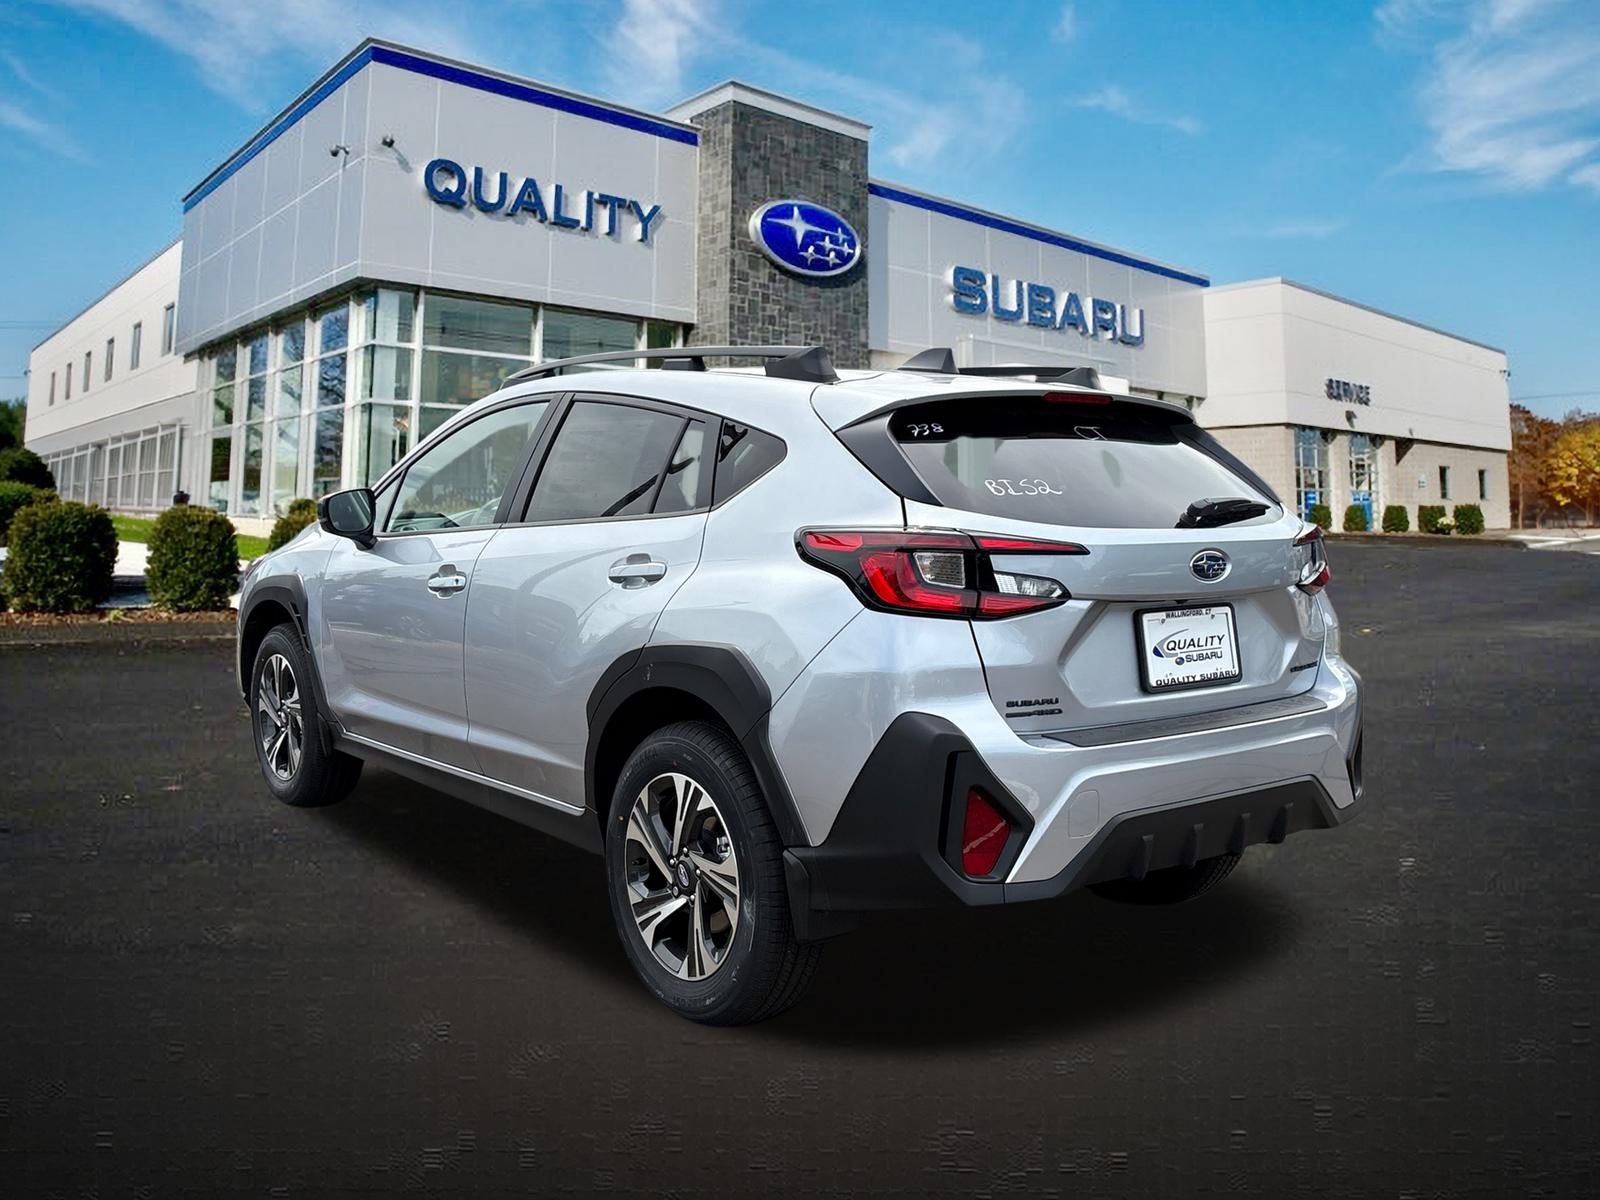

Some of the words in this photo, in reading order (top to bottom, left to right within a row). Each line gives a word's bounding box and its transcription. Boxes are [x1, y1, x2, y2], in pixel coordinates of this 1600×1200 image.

[423, 158, 662, 243] QUALITY
[949, 265, 1145, 347] SUBARU
[1166, 634, 1225, 652] QUALITY
[1185, 651, 1223, 663] SUBARU
[1155, 674, 1197, 686] QUALITY
[1199, 669, 1237, 681] SUBARU
[1006, 697, 1059, 708] SUBARU
